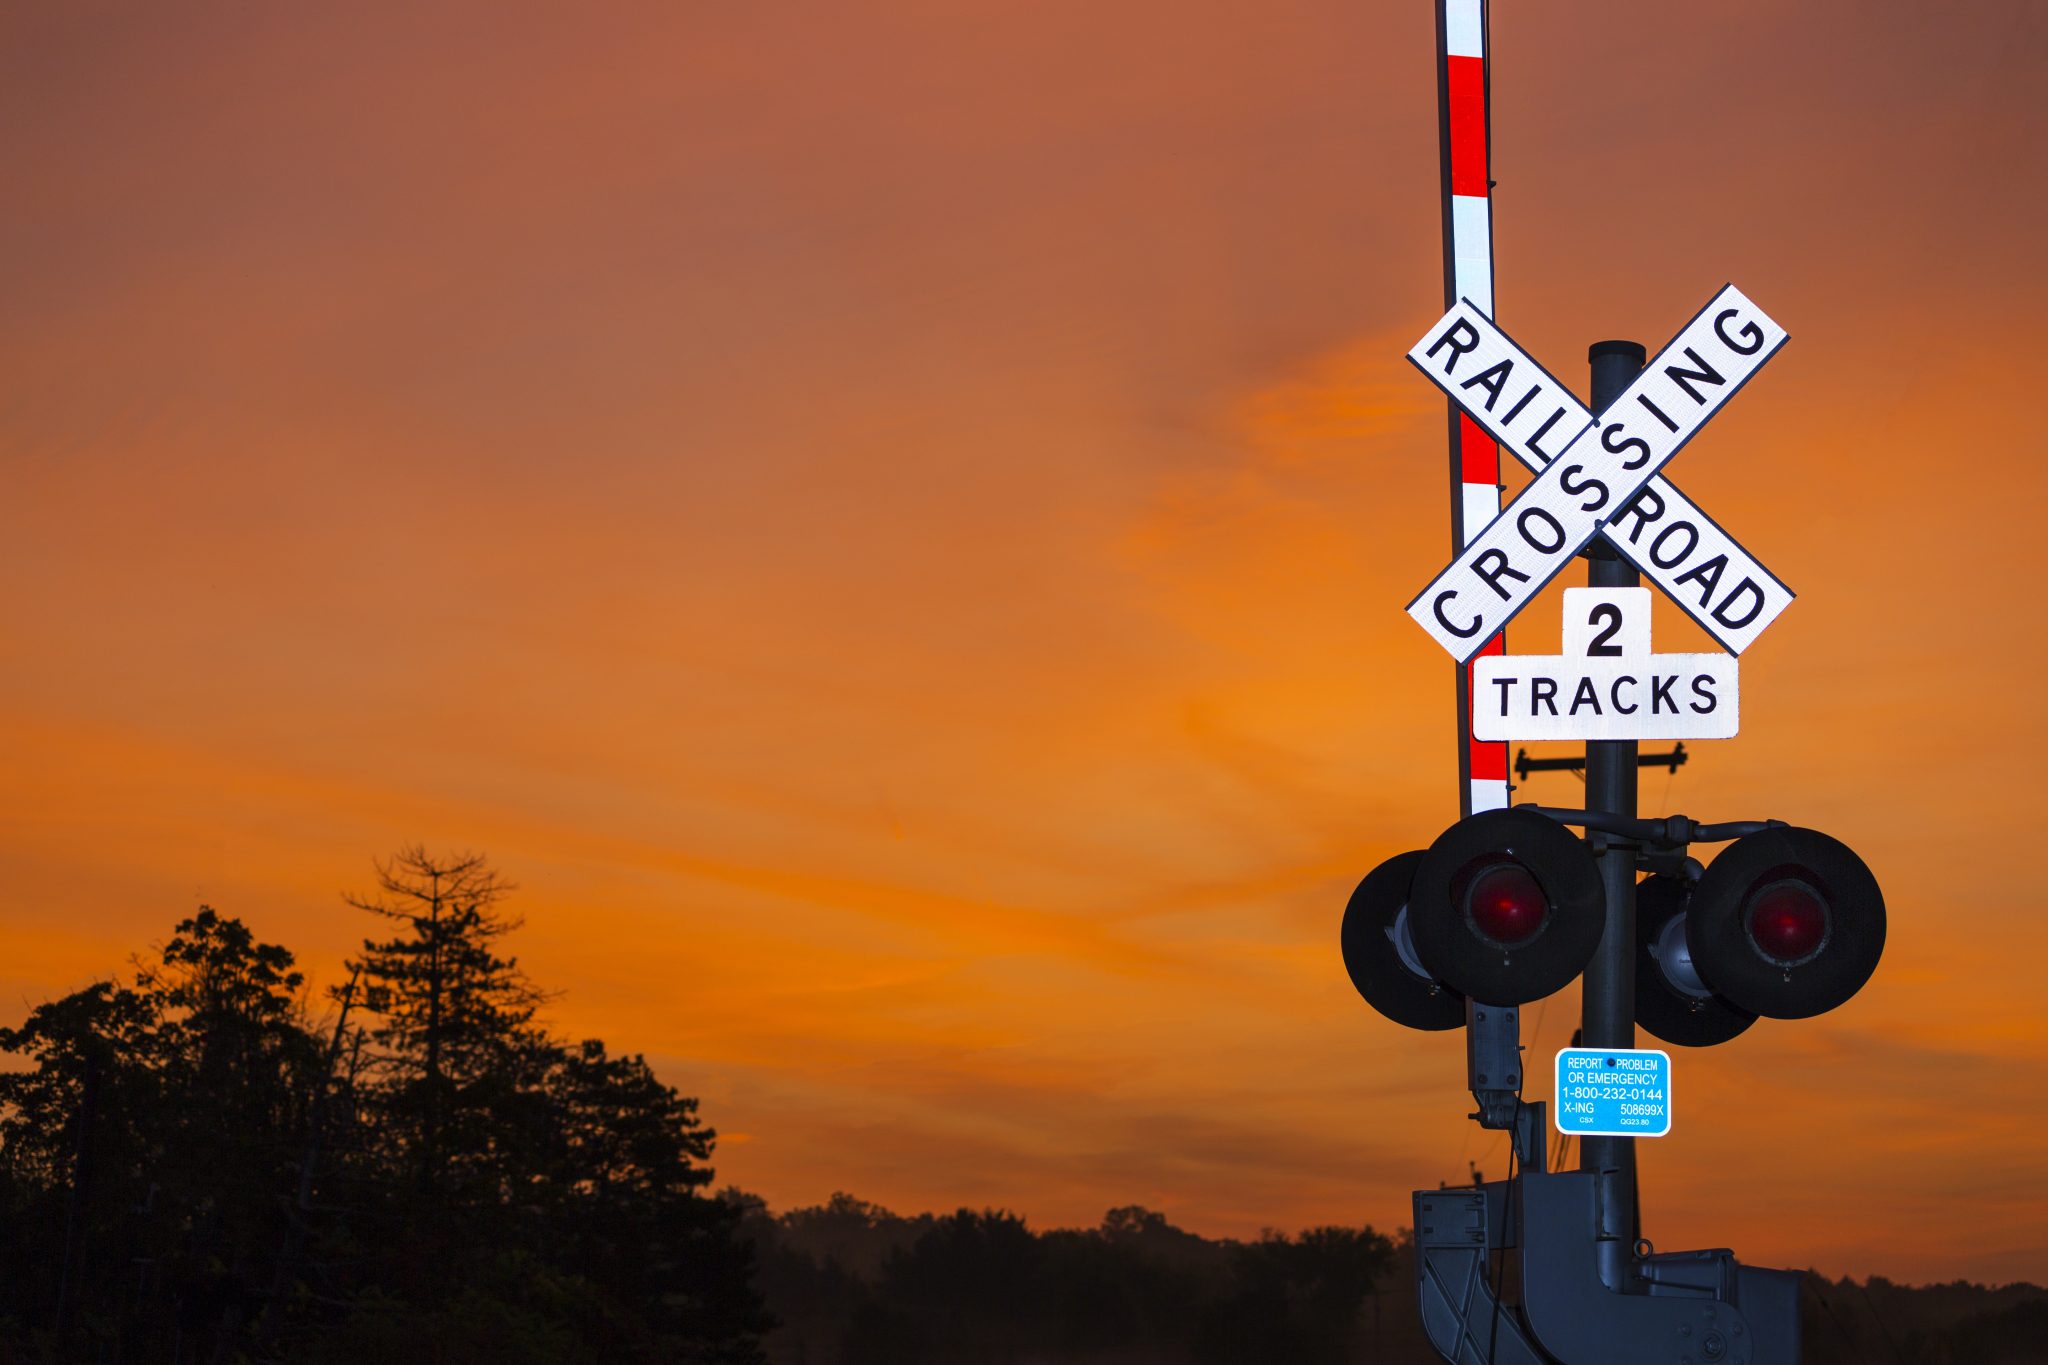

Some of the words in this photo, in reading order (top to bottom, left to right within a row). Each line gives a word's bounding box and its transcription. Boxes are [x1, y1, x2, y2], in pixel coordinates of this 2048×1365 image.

[1433, 308, 1765, 639] CROSSING
[1586, 602, 1623, 657] 2
[1492, 675, 1717, 716] TRACKS
[1567, 1057, 1603, 1069] REPORT
[1616, 1058, 1658, 1071] PROBLEM
[1567, 1071, 1585, 1084] OR
[1587, 1073, 1658, 1086] EMERGENCY
[1562, 1086, 1663, 1101] 1-800-232-0144
[1564, 1101, 1595, 1114] X-ING
[1620, 1103, 1664, 1116] 508699X
[1579, 1116, 1594, 1124] CSX
